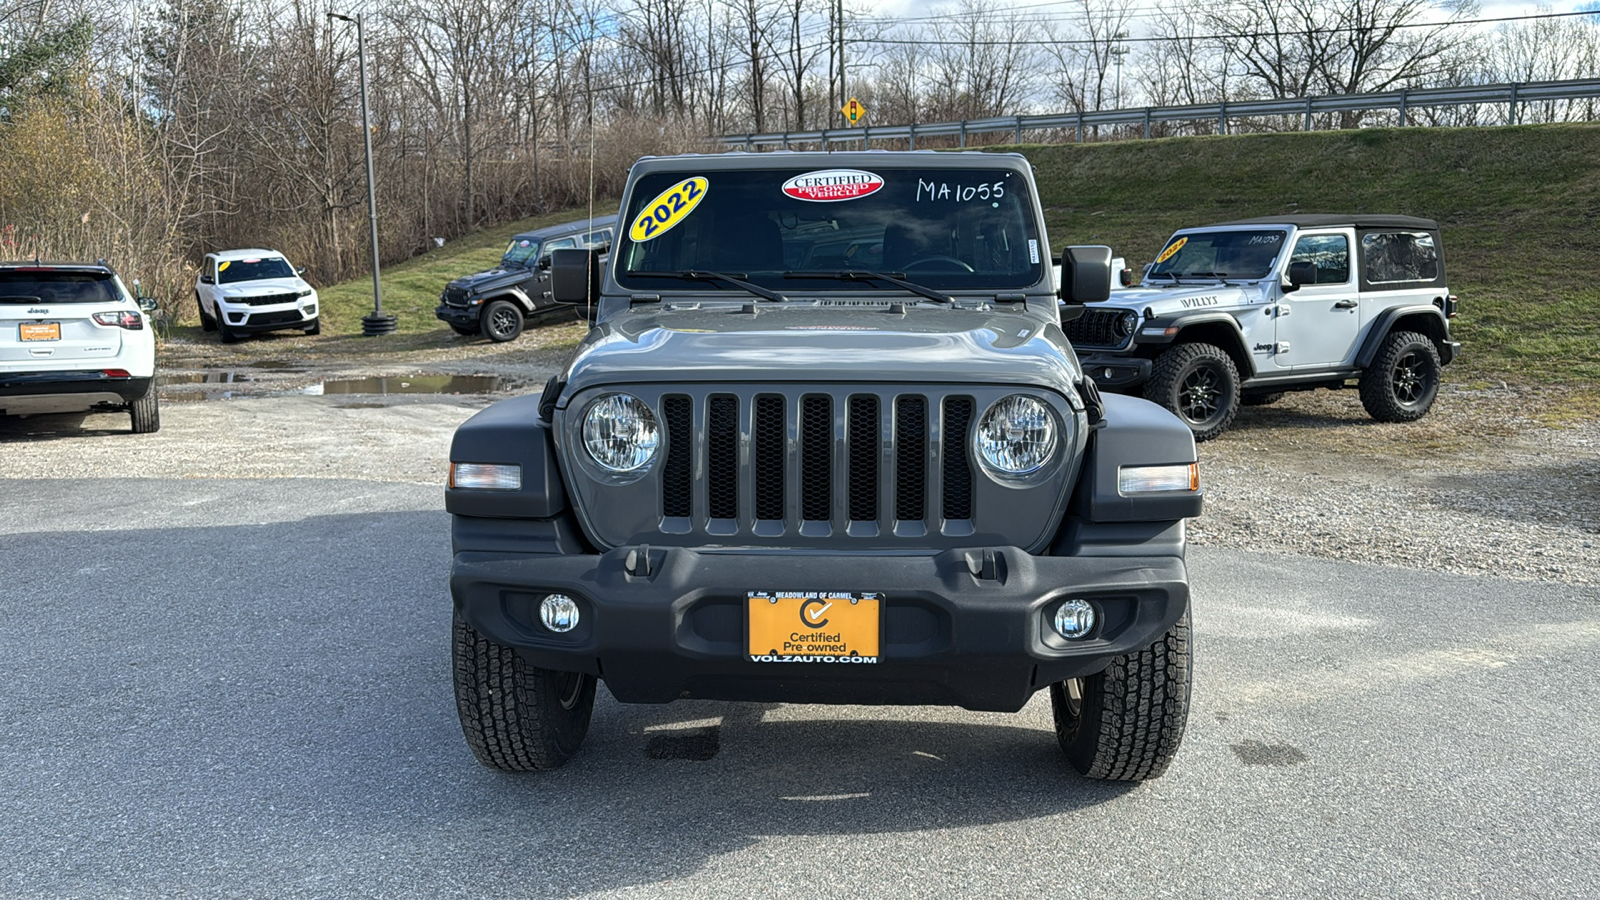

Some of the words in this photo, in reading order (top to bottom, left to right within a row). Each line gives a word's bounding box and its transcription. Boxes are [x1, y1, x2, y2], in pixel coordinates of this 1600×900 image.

[794, 175, 872, 188] CERTIFIED
[798, 183, 869, 194] PRE-OWNED
[809, 189, 859, 198] VEHICLE
[916, 178, 1004, 202] MA1055
[639, 180, 702, 237] 2022
[1160, 239, 1185, 261] 2024
[1180, 295, 1218, 309] WILLYS
[1253, 342, 1273, 352] Jeep
[775, 591, 818, 599] MEADOWLAND
[828, 592, 853, 600] CARMEL
[790, 632, 841, 643] Certified
[783, 642, 847, 653] Pre-owned
[750, 655, 878, 664] VOLZAUTO.COM
